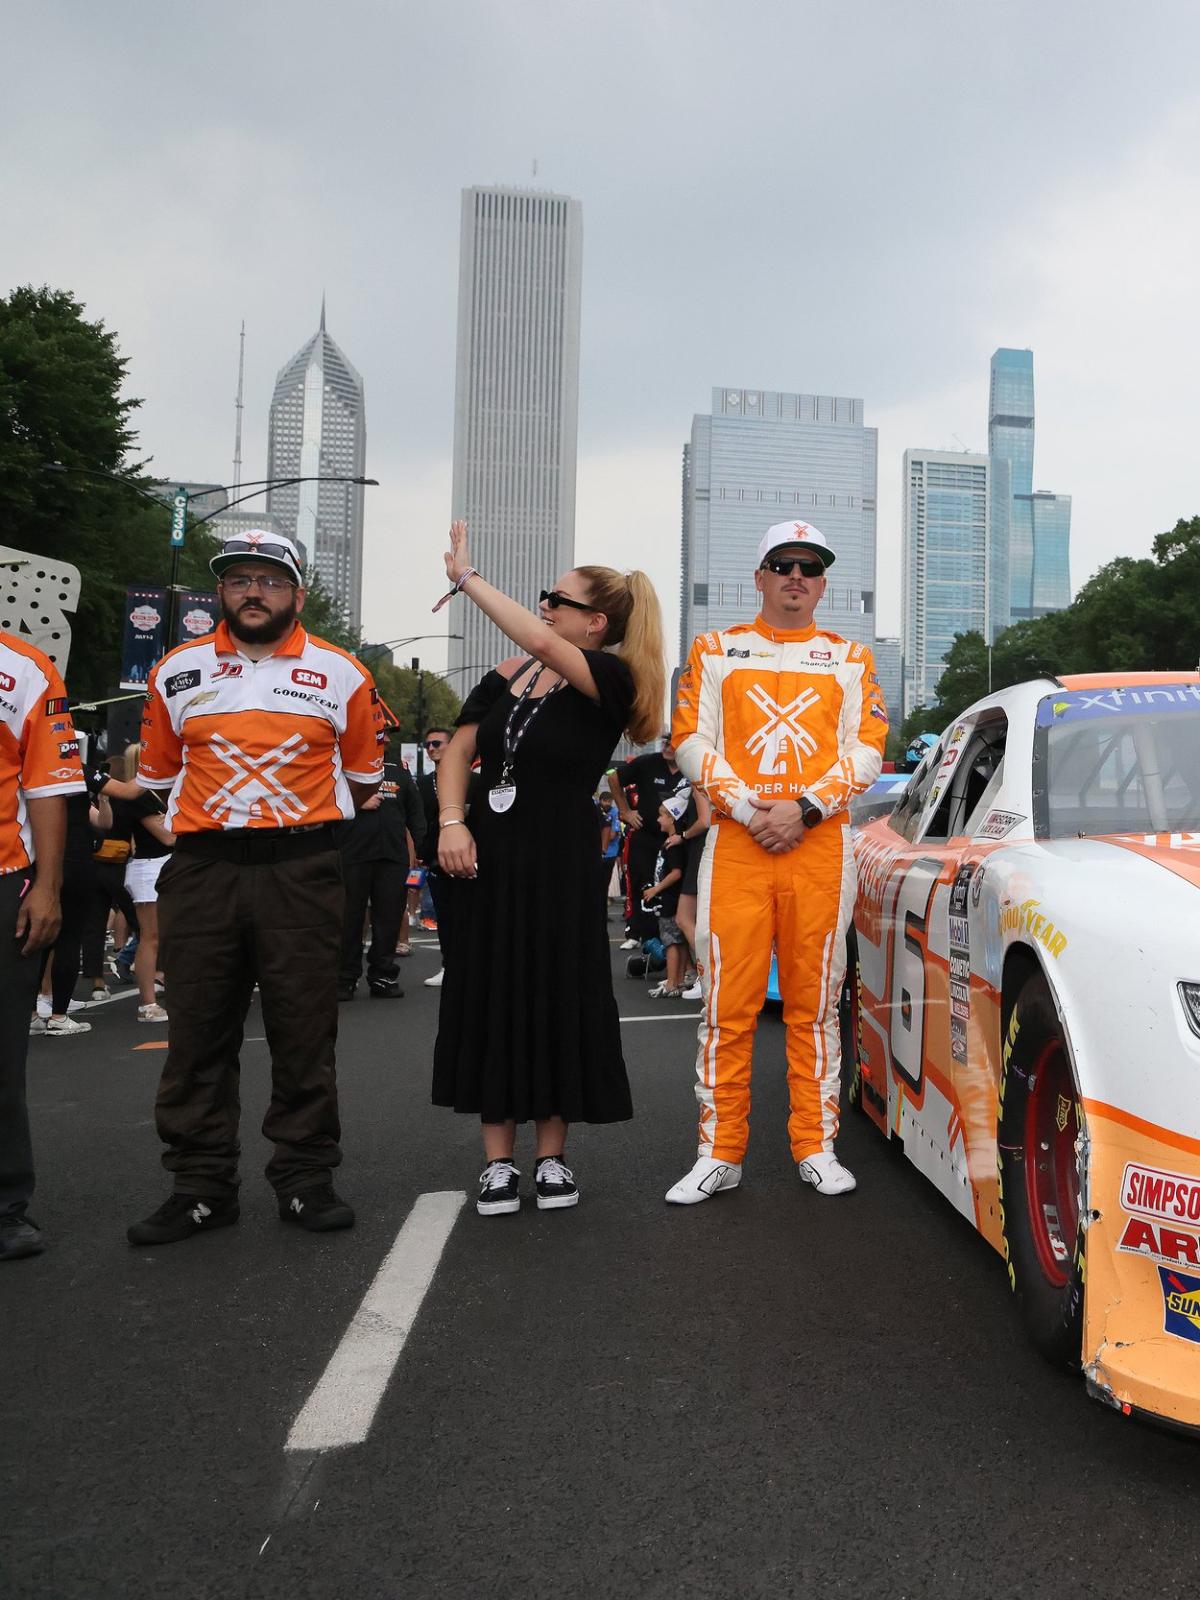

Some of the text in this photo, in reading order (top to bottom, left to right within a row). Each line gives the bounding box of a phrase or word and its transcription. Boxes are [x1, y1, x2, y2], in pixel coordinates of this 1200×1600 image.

[173, 495, 187, 541] C330
[296, 671, 322, 686] SEM
[273, 687, 339, 712] GOODYEAR
[889, 856, 944, 1095] 6
